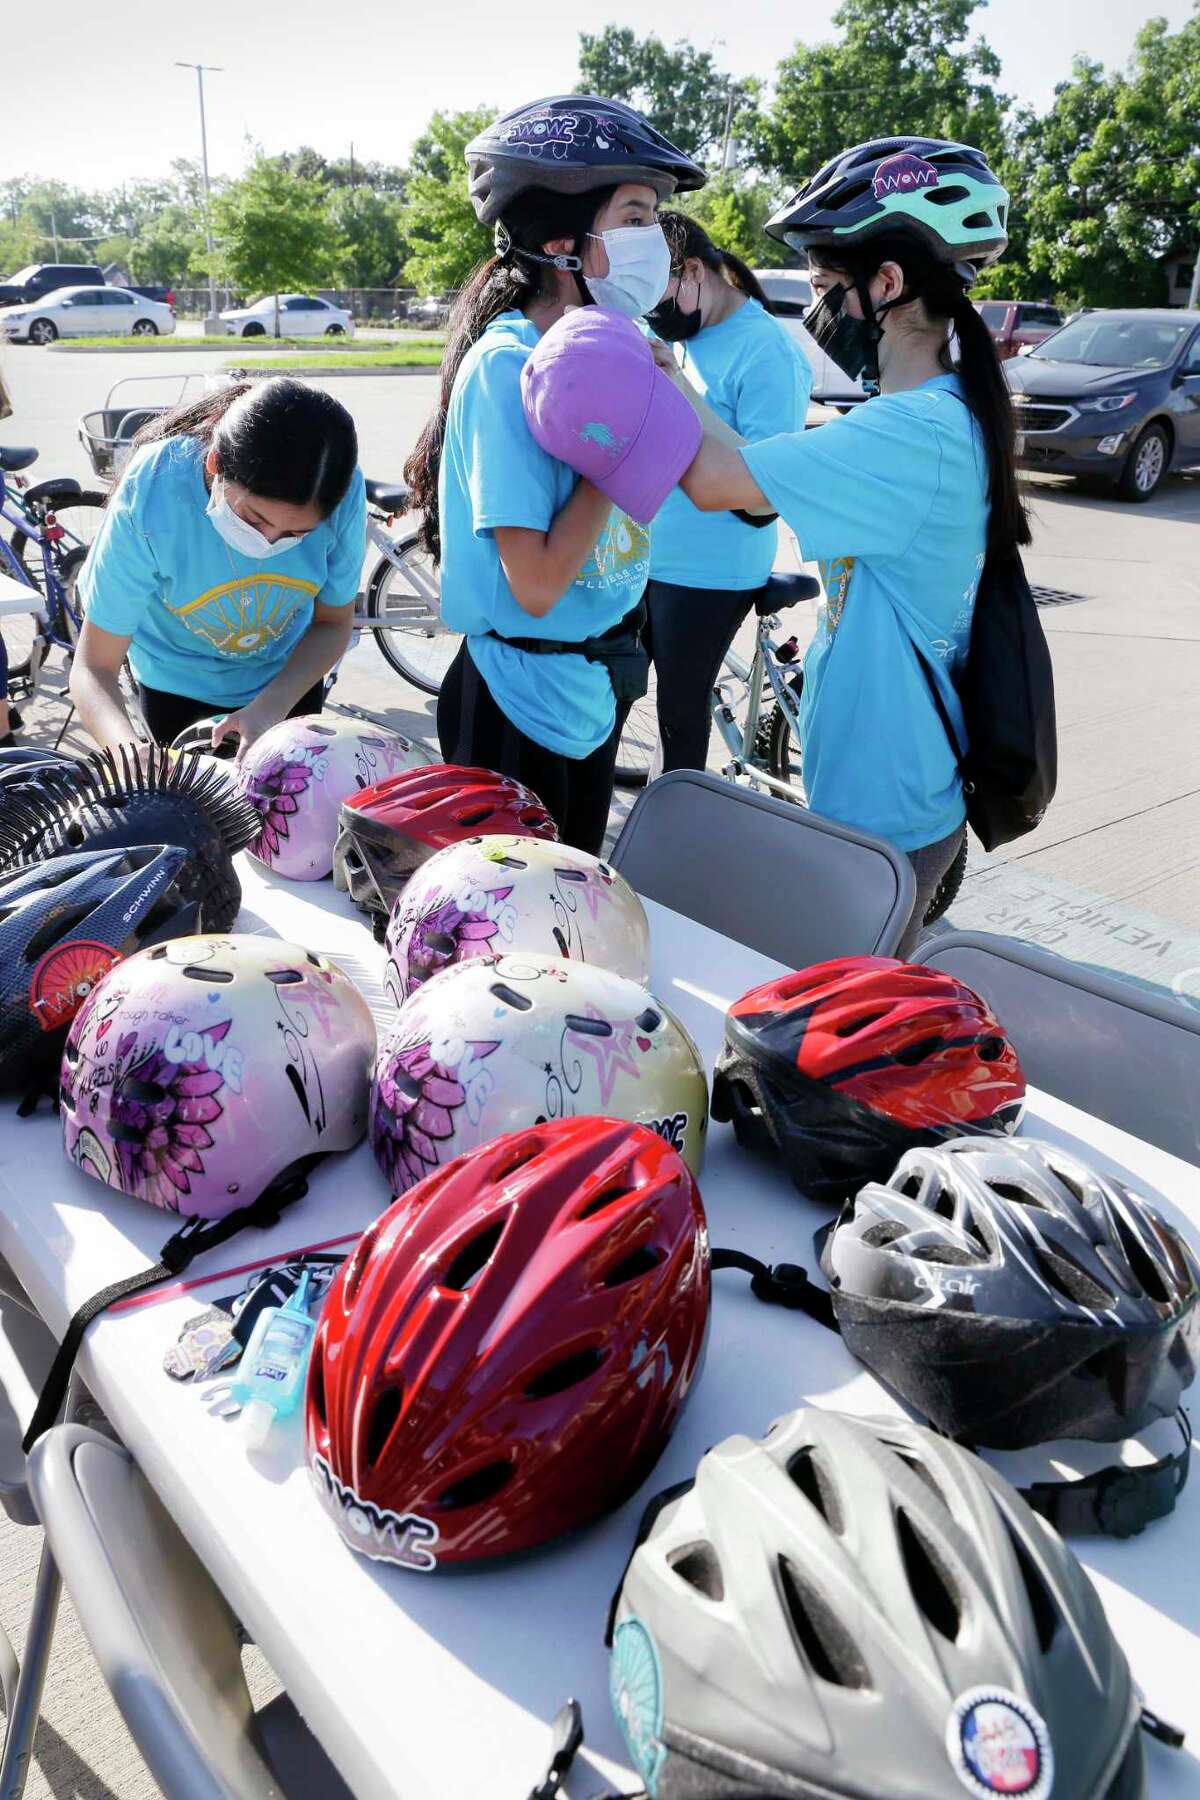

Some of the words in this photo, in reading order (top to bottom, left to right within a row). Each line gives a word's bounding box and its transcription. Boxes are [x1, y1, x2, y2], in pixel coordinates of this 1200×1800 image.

[511, 119, 574, 138] WOW
[875, 169, 937, 191] WOW
[123, 868, 166, 922] SCHWINN
[456, 888, 519, 944] LOVE
[1010, 886, 1172, 957] VEHICLE
[164, 1025, 245, 1095] LOVE
[430, 1037, 495, 1127] LOVE
[914, 1269, 983, 1296] altair
[314, 1459, 429, 1553] WOW
